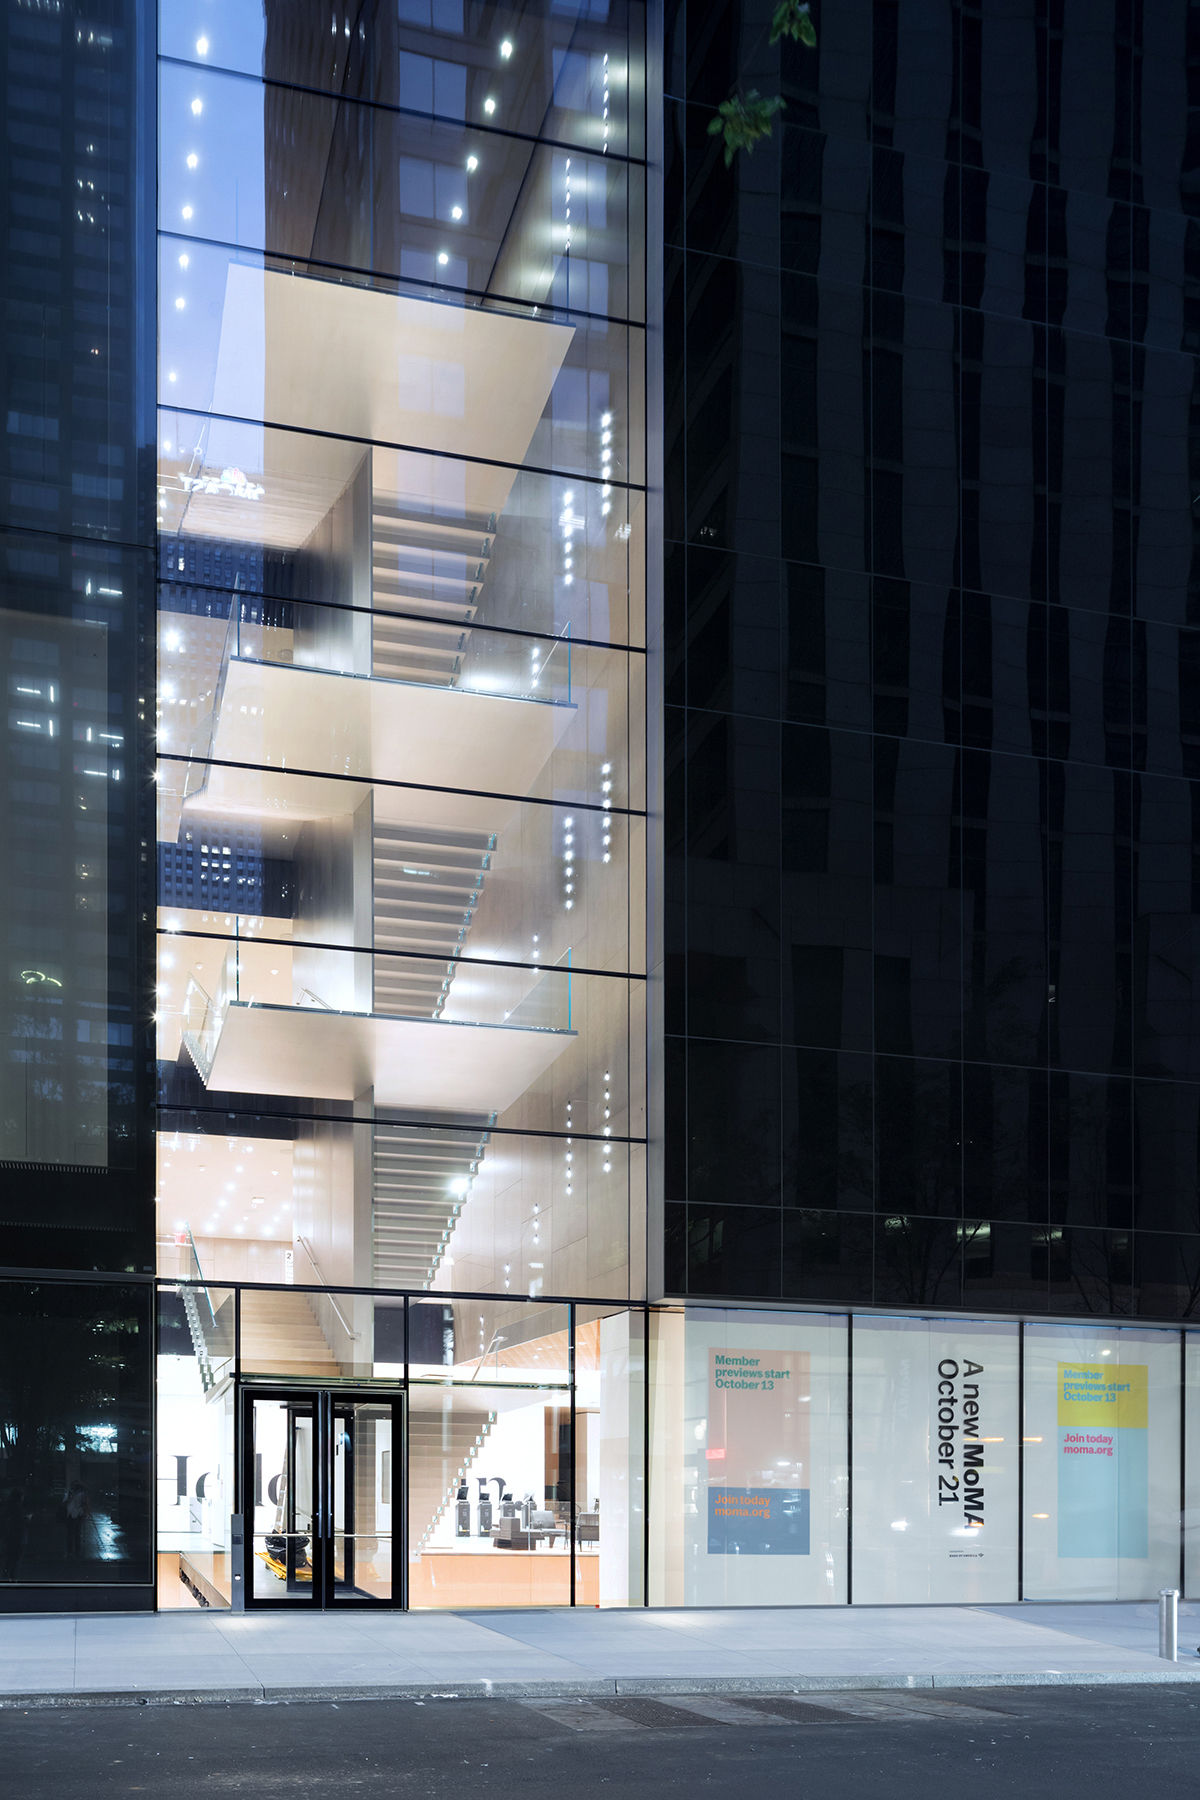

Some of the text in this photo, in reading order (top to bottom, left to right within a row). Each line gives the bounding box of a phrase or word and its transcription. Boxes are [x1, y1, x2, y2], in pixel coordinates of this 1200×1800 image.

[715, 1355, 760, 1366] Member
[715, 1368, 790, 1379] previews start
[963, 1359, 984, 1377] A
[1063, 1369, 1104, 1380] Member
[715, 1379, 775, 1390] October 13
[1063, 1381, 1131, 1393] previews start
[1063, 1391, 1117, 1402] October 13
[963, 1384, 979, 1438] new
[938, 1359, 959, 1506] October 21
[1064, 1433, 1114, 1445] Join today
[1064, 1446, 1114, 1456] moma.org
[963, 1444, 985, 1529] MoMA
[714, 1494, 771, 1507] Join today
[714, 1508, 771, 1519] moma.org
